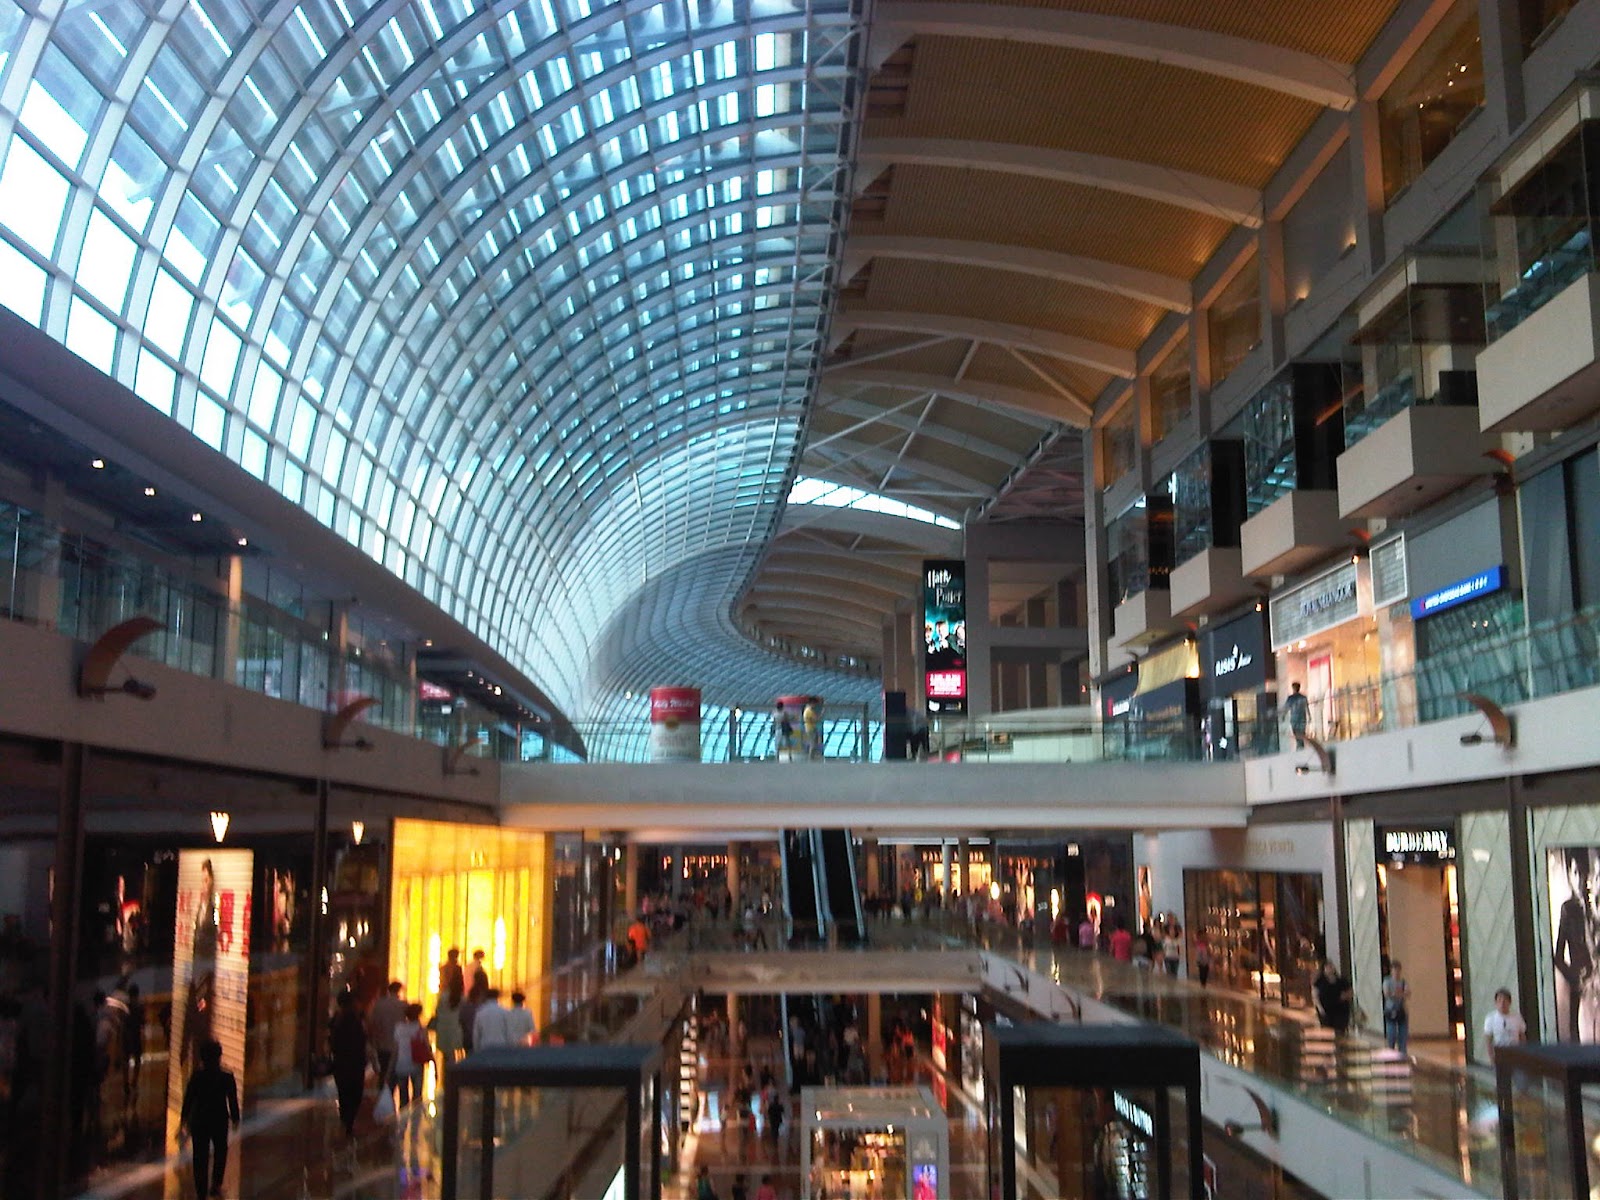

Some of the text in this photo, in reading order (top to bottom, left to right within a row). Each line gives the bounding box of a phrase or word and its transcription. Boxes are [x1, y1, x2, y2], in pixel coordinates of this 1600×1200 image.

[927, 569, 952, 588] Harry
[936, 587, 962, 607] Potter
[1386, 831, 1448, 852] BURBERRY
